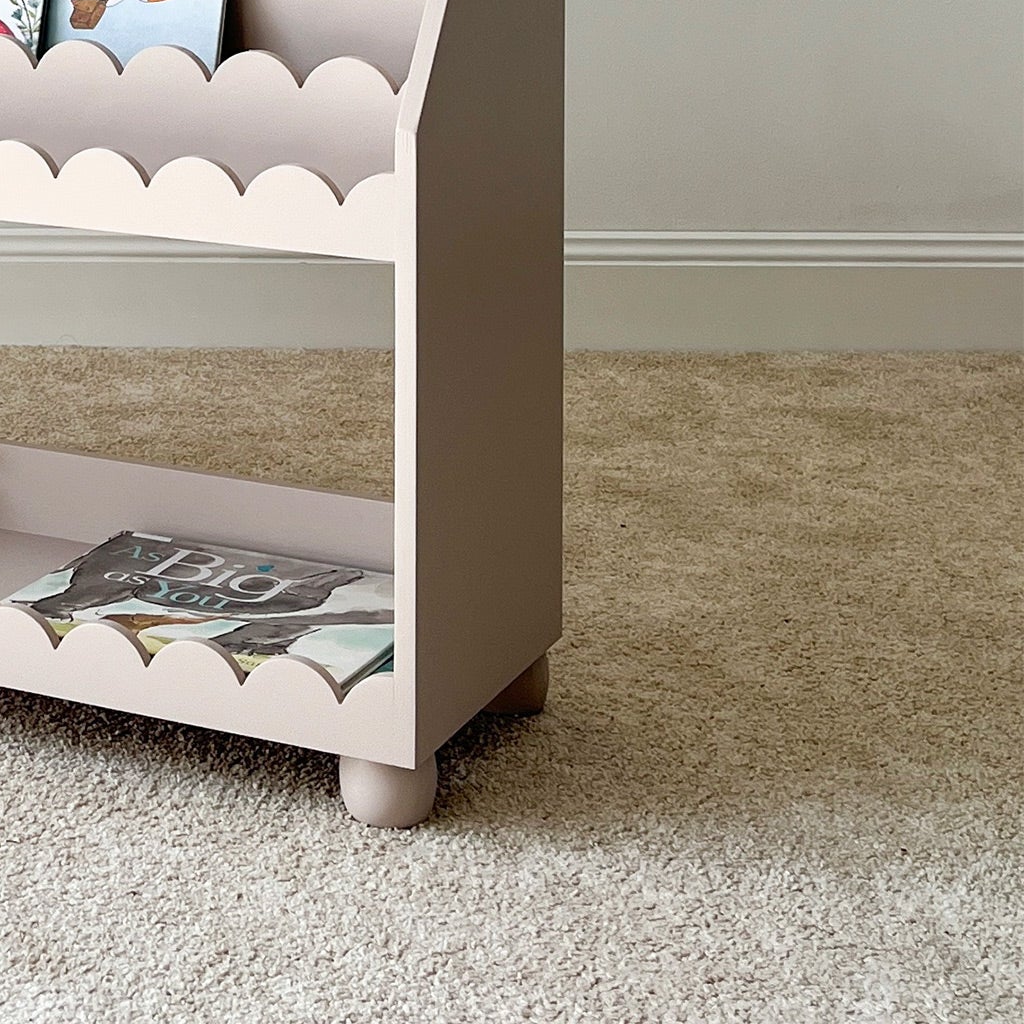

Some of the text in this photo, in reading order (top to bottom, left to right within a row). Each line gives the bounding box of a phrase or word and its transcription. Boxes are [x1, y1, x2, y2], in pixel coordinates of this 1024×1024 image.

[103, 571, 233, 610] as You
[110, 545, 295, 603] As Big
